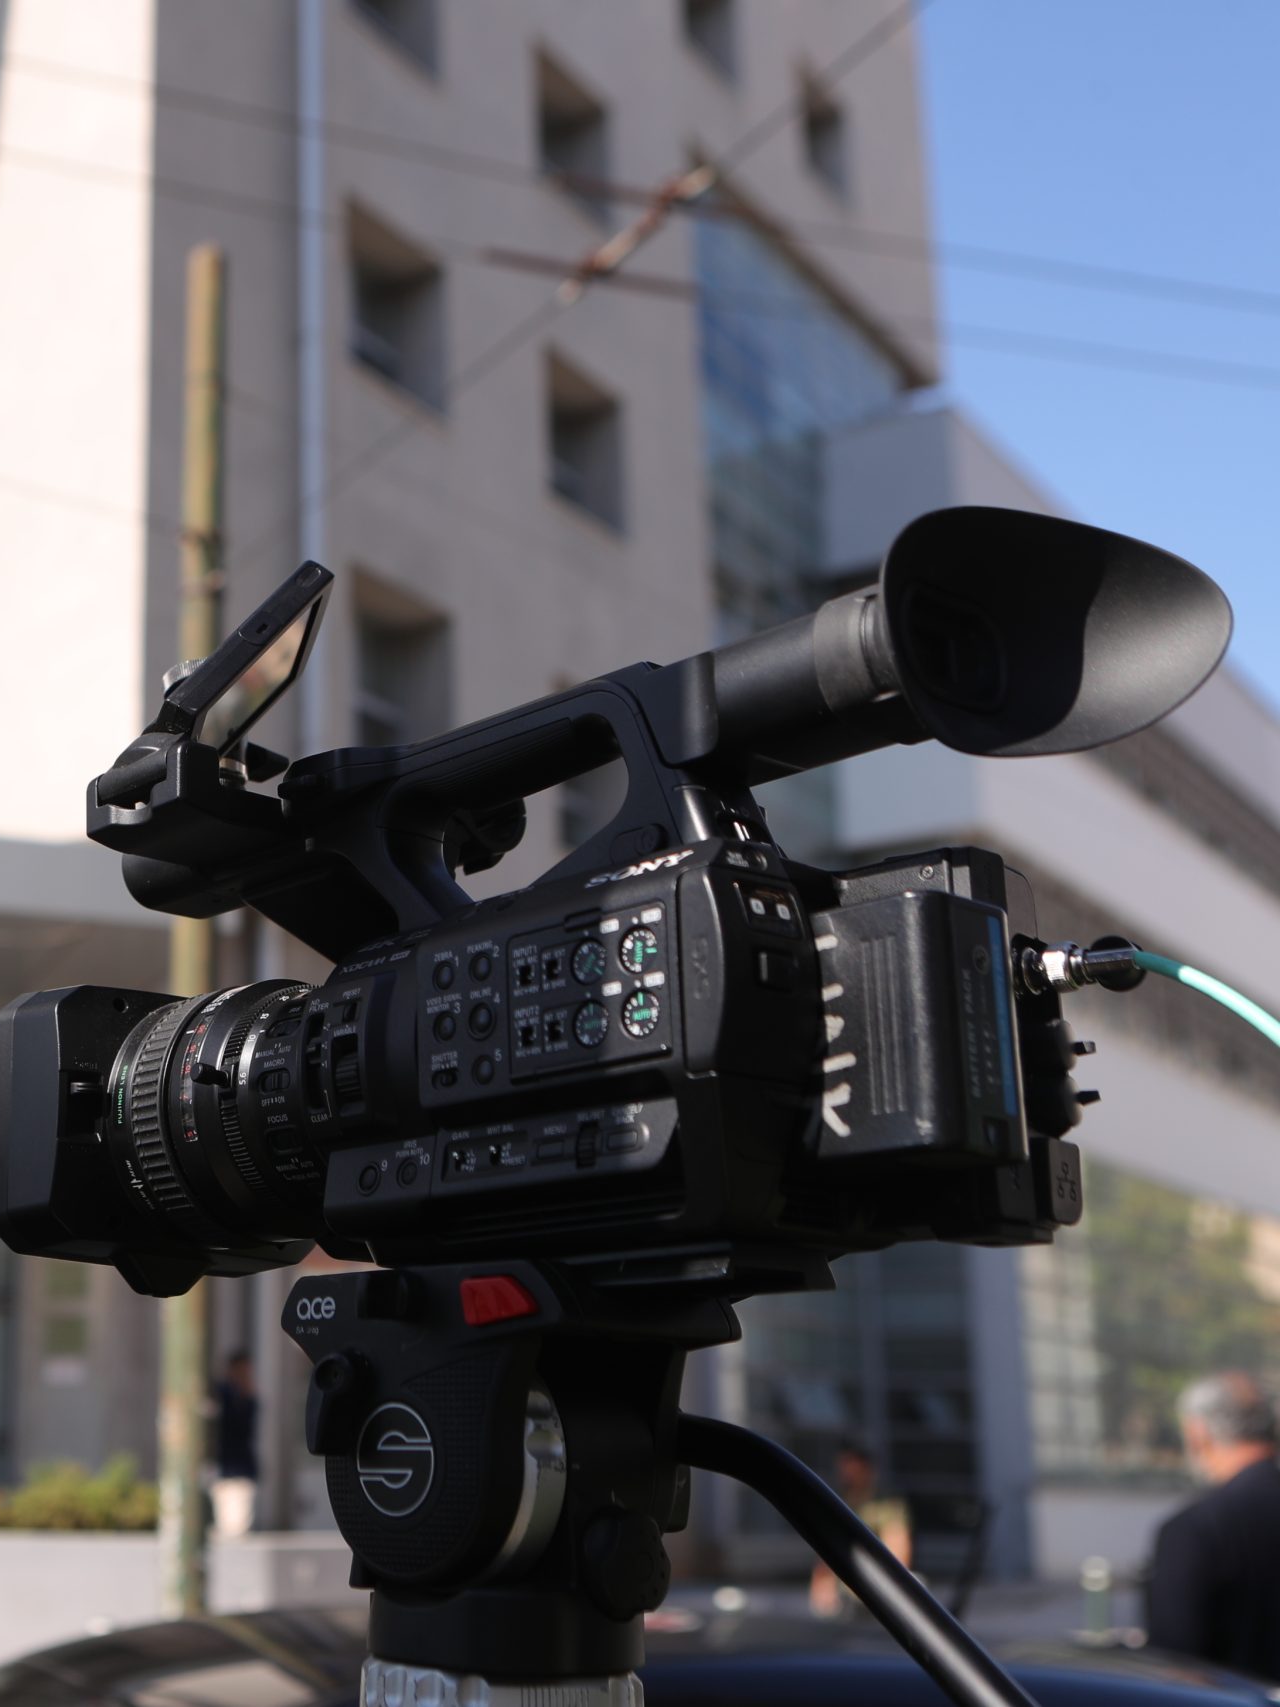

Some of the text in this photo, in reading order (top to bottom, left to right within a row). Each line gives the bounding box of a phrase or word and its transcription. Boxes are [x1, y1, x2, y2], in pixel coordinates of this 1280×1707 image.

[584, 850, 695, 889] SONY
[433, 950, 453, 962] ZEBRA
[492, 945, 500, 958] 2
[634, 940, 643, 963] AUTO
[470, 986, 492, 999] ONLINE
[493, 992, 500, 1004] 4
[453, 1001, 461, 1014] 3
[632, 1008, 651, 1021] AUTO
[247, 1033, 256, 1044] 10
[960, 967, 982, 1099] BATTERY PACK
[278, 1045, 291, 1055] AUTO
[494, 1048, 503, 1062] 5
[263, 1058, 285, 1069] MACRO
[431, 1051, 458, 1063] SHUTTER
[238, 1072, 247, 1086] 5.6
[116, 1064, 128, 1125] FUJINON LENS
[267, 1114, 288, 1124] FOCUS
[310, 1113, 329, 1123] CLEAR
[543, 1124, 567, 1136] MENU
[381, 1160, 388, 1172] 9
[420, 1153, 430, 1166] 10
[297, 1296, 336, 1321] ace
